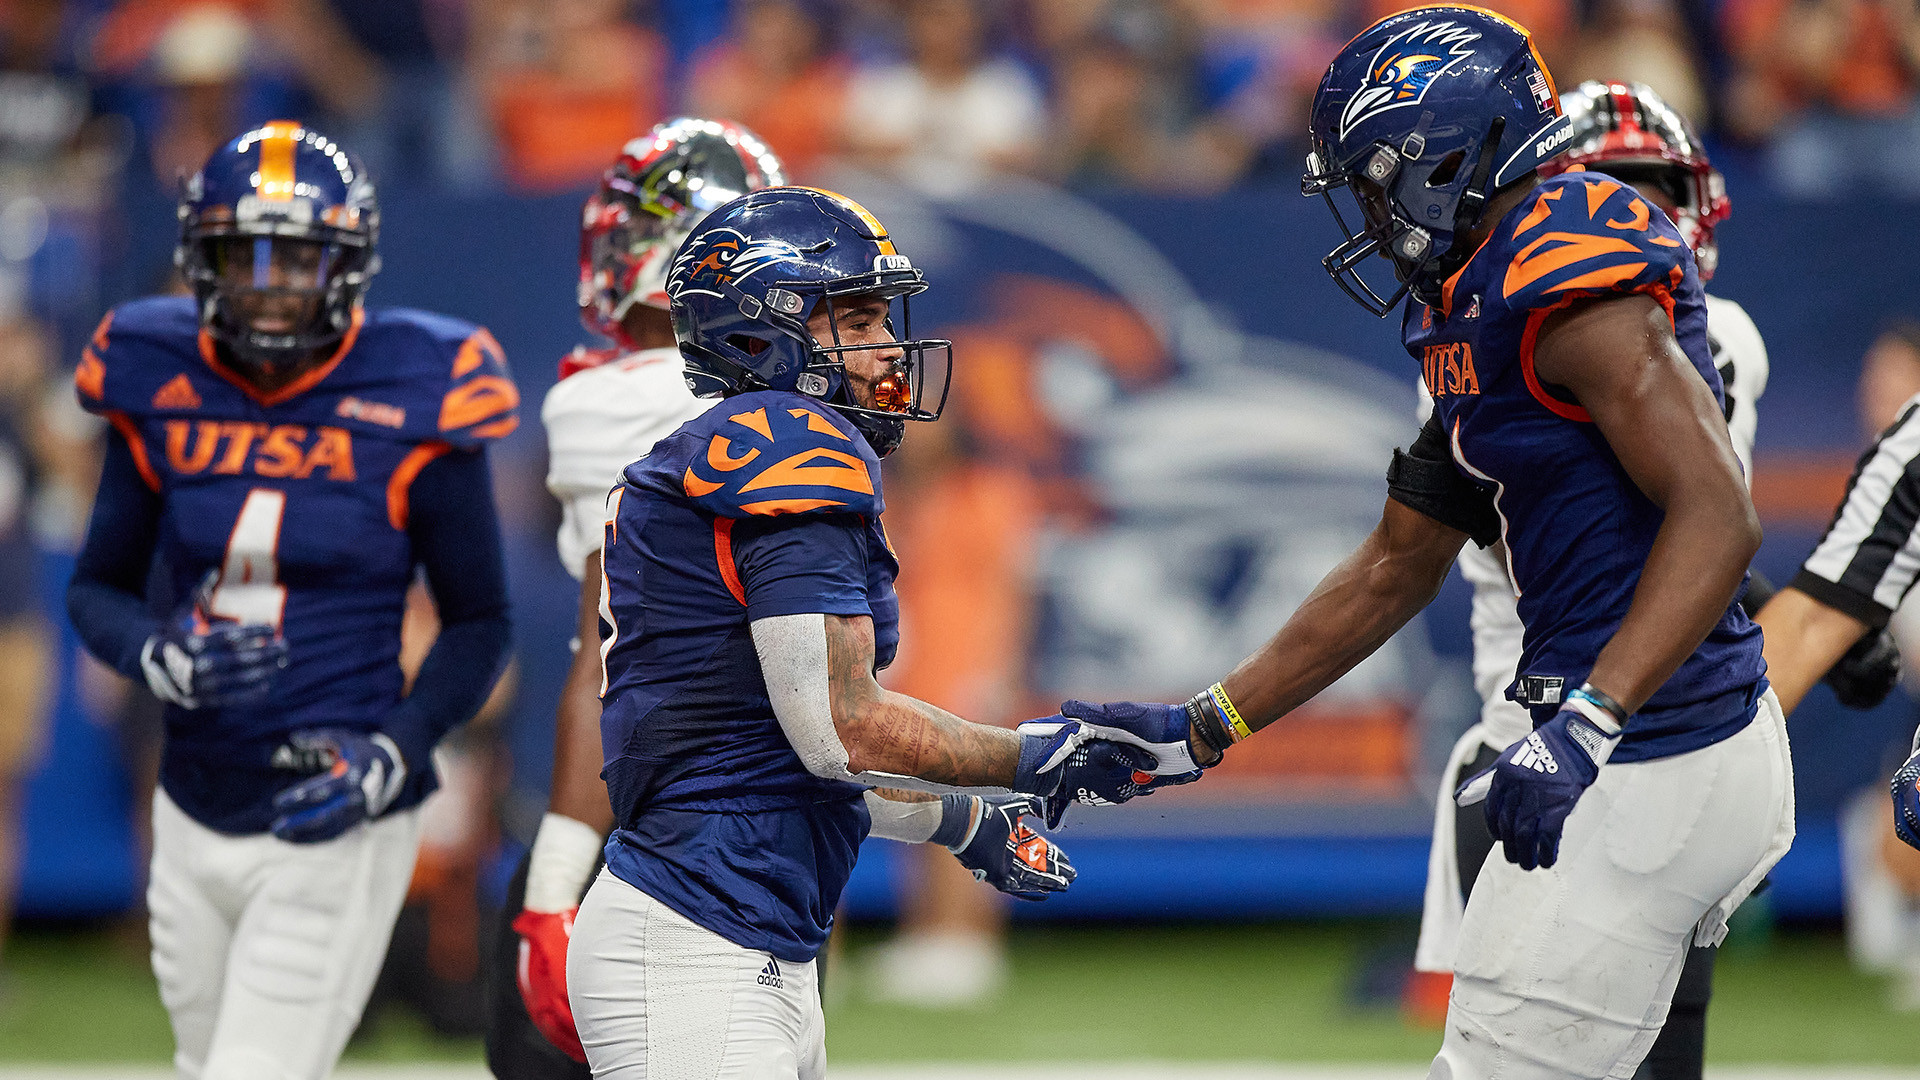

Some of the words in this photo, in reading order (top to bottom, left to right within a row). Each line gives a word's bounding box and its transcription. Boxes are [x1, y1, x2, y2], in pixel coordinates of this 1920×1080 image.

[1423, 342, 1480, 398] UTSA
[163, 419, 357, 482] UTSA
[210, 487, 288, 642] 4
[1526, 730, 1559, 775] adidas
[756, 974, 784, 989] adidas
